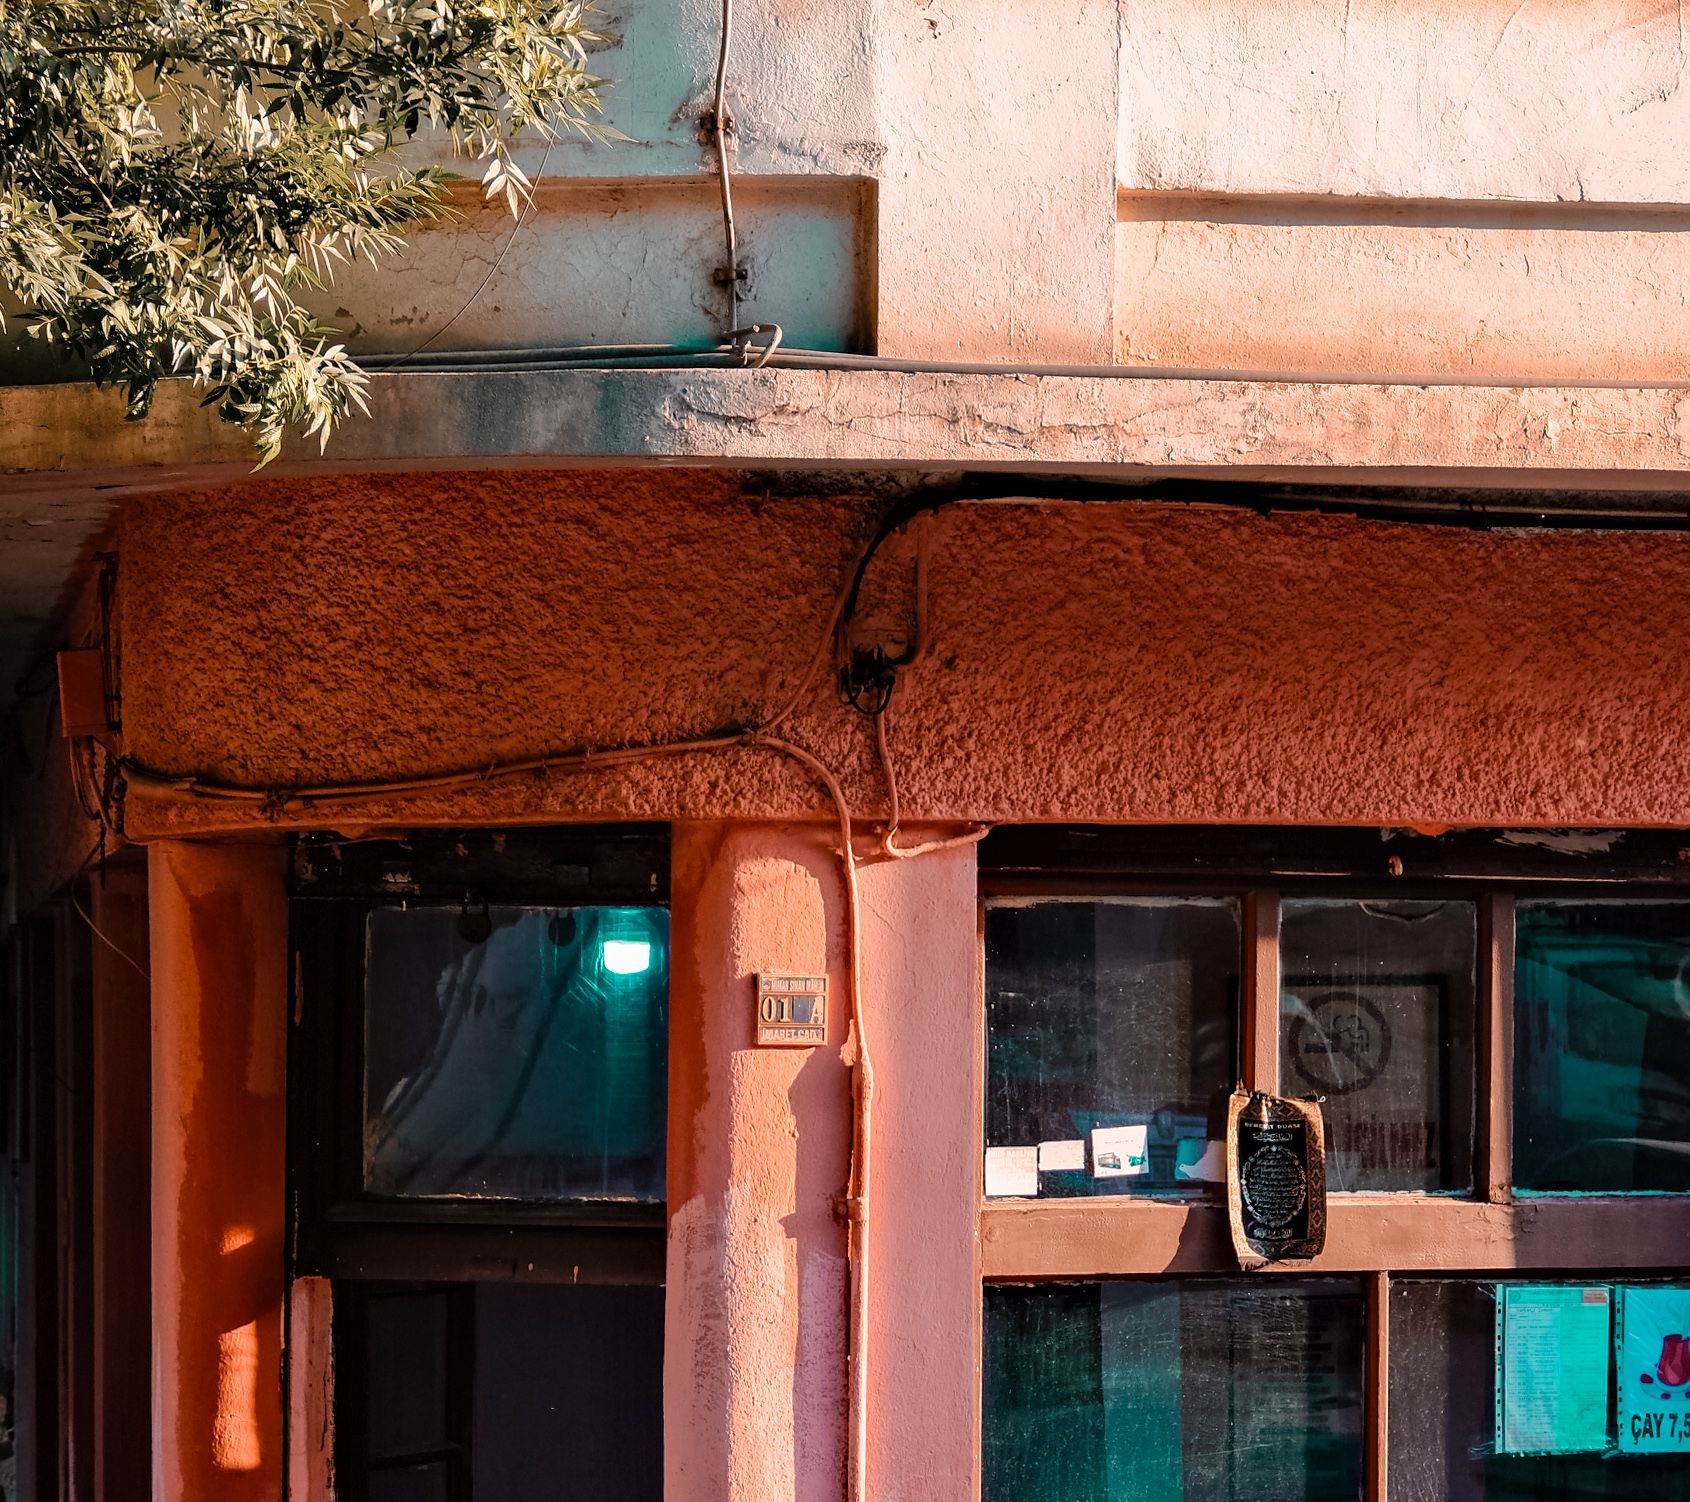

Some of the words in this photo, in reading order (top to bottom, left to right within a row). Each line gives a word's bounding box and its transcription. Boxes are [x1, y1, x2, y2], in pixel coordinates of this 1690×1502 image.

[762, 996, 791, 1023] 01
[809, 995, 824, 1024] A
[1632, 1413, 1664, 1445] ÇAY
